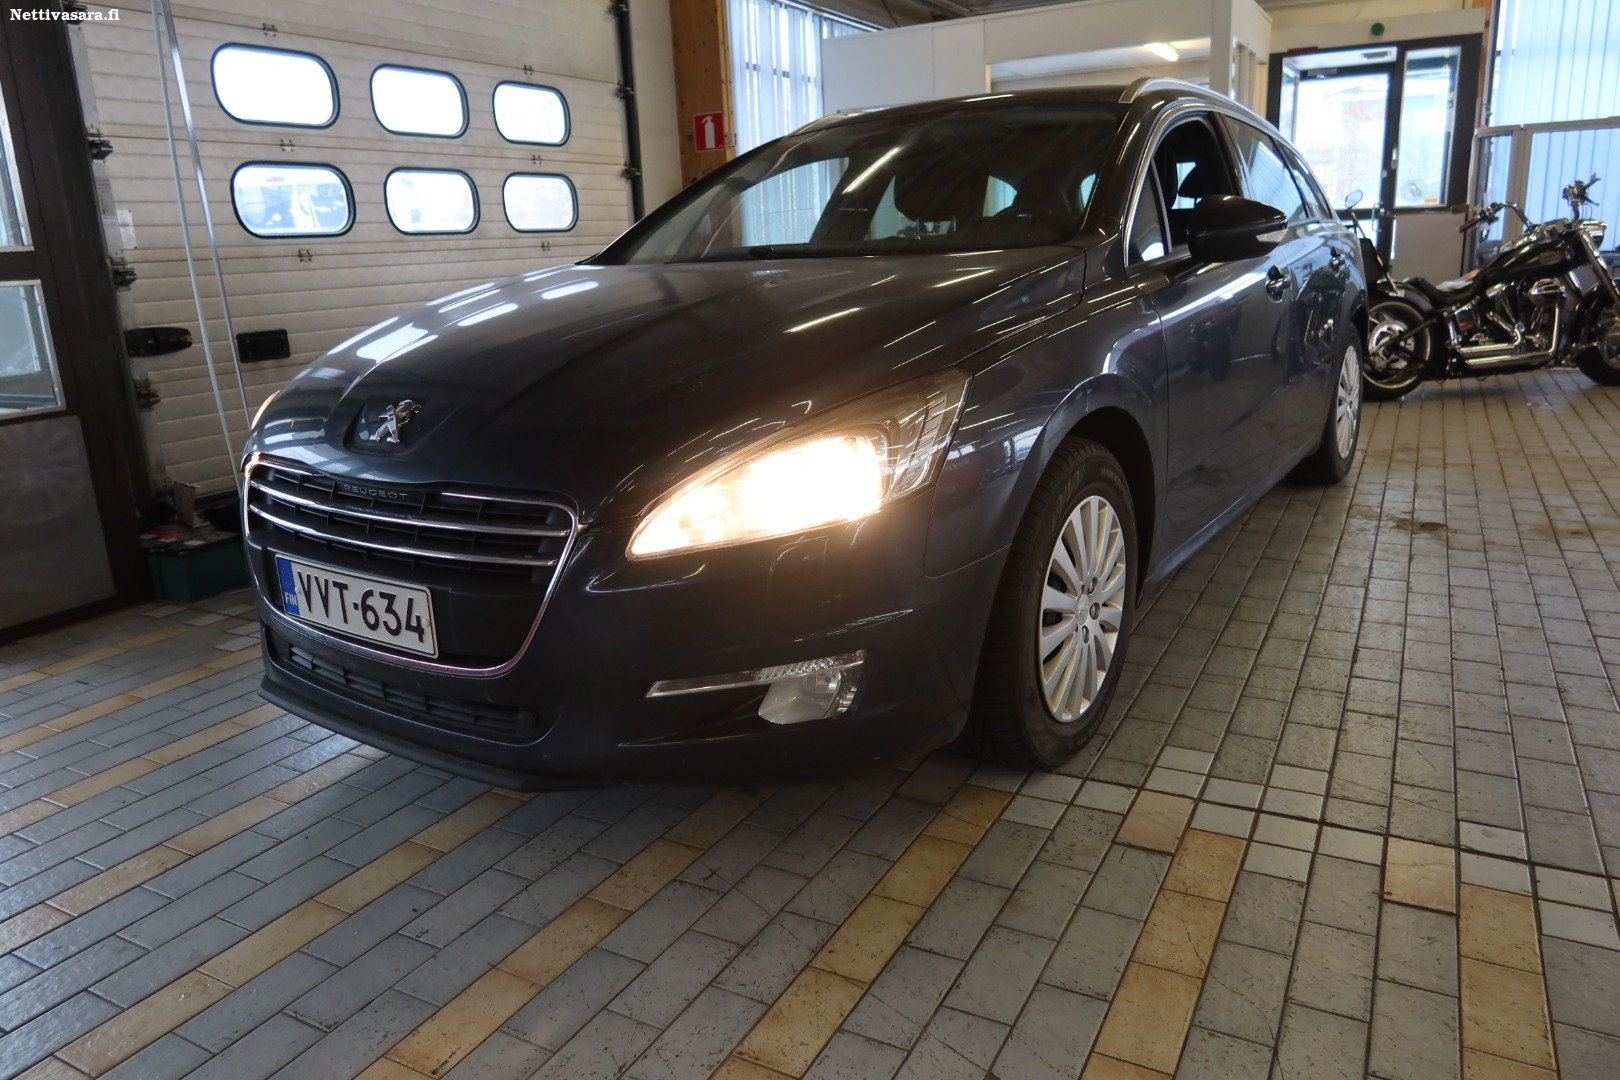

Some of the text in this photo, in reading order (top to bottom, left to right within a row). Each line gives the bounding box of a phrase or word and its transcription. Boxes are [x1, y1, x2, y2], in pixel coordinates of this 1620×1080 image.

[343, 484, 408, 500] PEUGEOT
[285, 591, 298, 607] FIN
[297, 570, 425, 643] VVT-634
